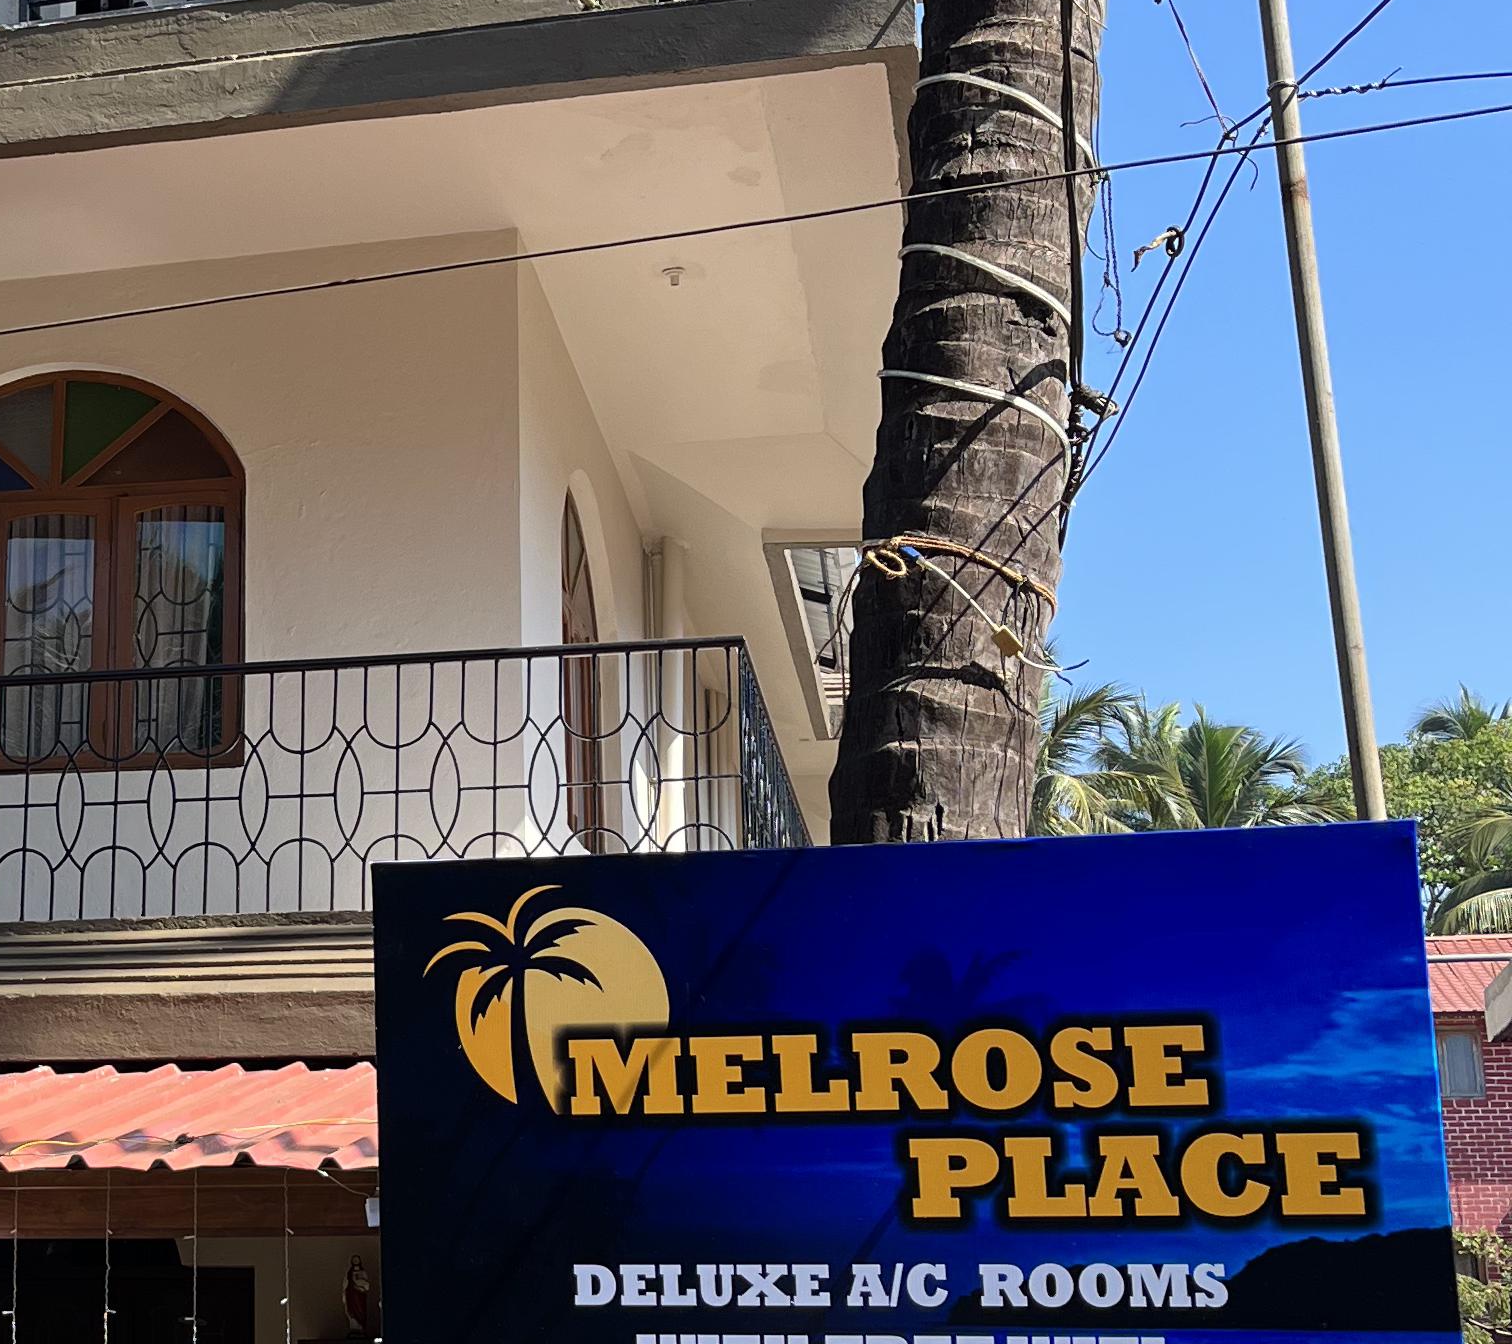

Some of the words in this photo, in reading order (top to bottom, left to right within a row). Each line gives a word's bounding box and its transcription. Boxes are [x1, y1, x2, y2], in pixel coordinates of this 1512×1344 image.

[567, 1023, 1210, 1116] MELROSE
[908, 1132, 1366, 1218] PLACE
[573, 1263, 831, 1307] DELUXE
[846, 1262, 949, 1308] A/C
[978, 1263, 1229, 1308] ROOMS
